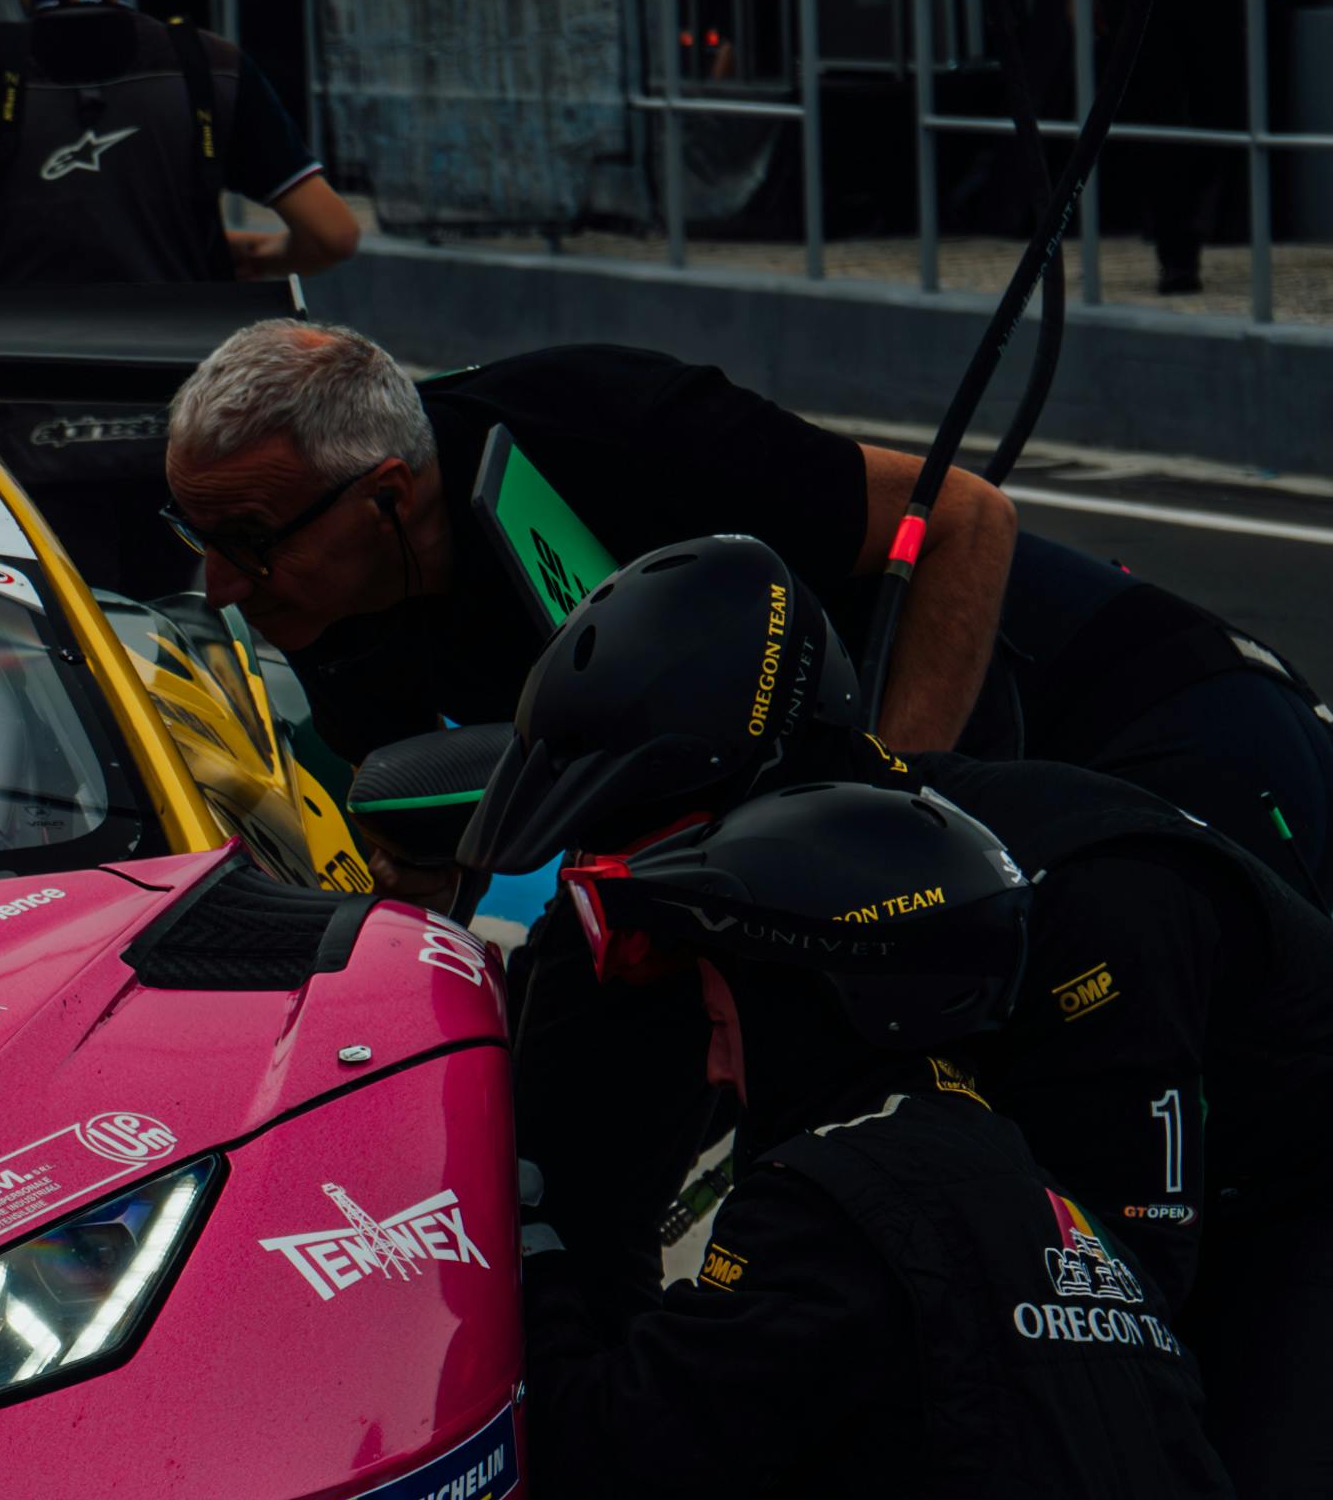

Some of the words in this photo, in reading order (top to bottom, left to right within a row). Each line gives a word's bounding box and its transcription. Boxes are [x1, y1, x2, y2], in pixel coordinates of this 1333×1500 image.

[747, 641, 782, 737] OREGON
[768, 583, 787, 637] TEAM
[781, 635, 816, 736] UNIVET
[882, 886, 946, 917] TEAM
[743, 922, 895, 956] UNIVET
[1058, 970, 1114, 1013] OMP
[1151, 1089, 1182, 1193] 1
[1013, 1302, 1145, 1347] OREGON
